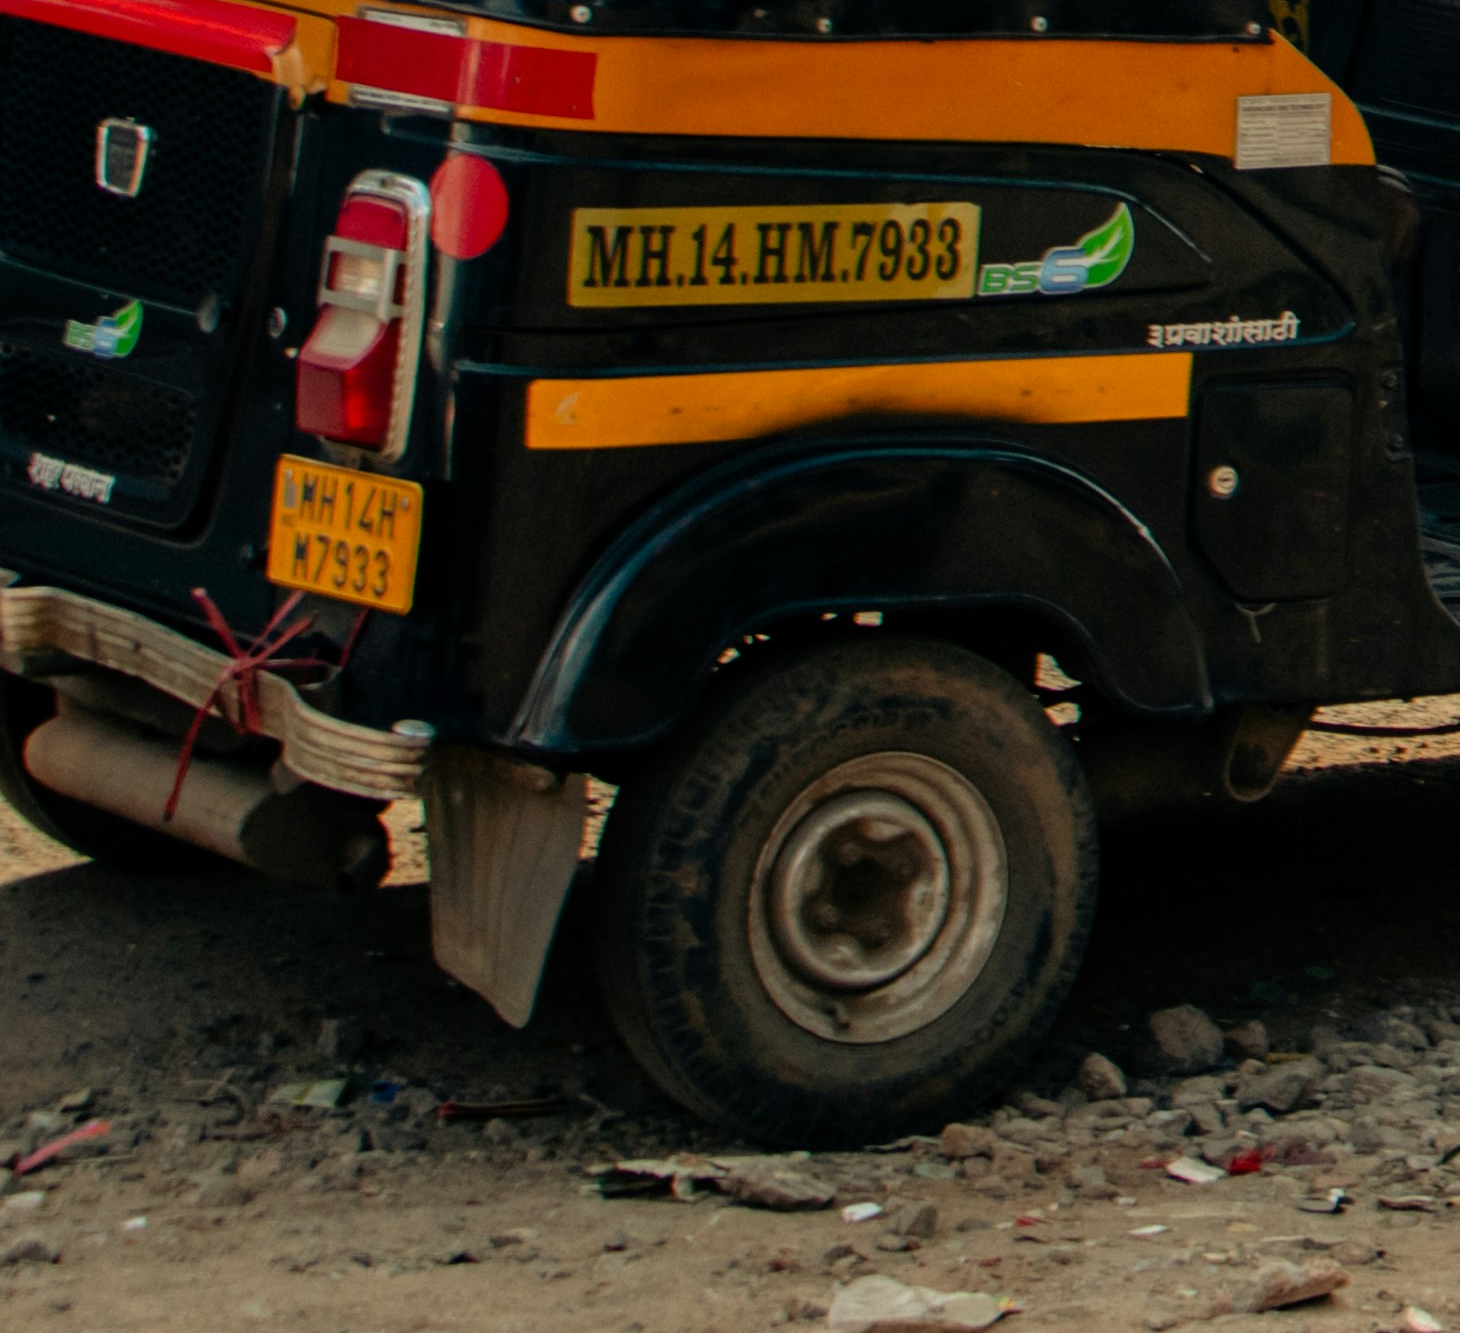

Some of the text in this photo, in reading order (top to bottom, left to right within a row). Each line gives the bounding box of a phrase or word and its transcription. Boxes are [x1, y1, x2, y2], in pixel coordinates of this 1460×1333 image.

[583, 216, 964, 288] MH.14.HM.7933
[977, 246, 1088, 296] BS6
[292, 531, 390, 599] M7933
